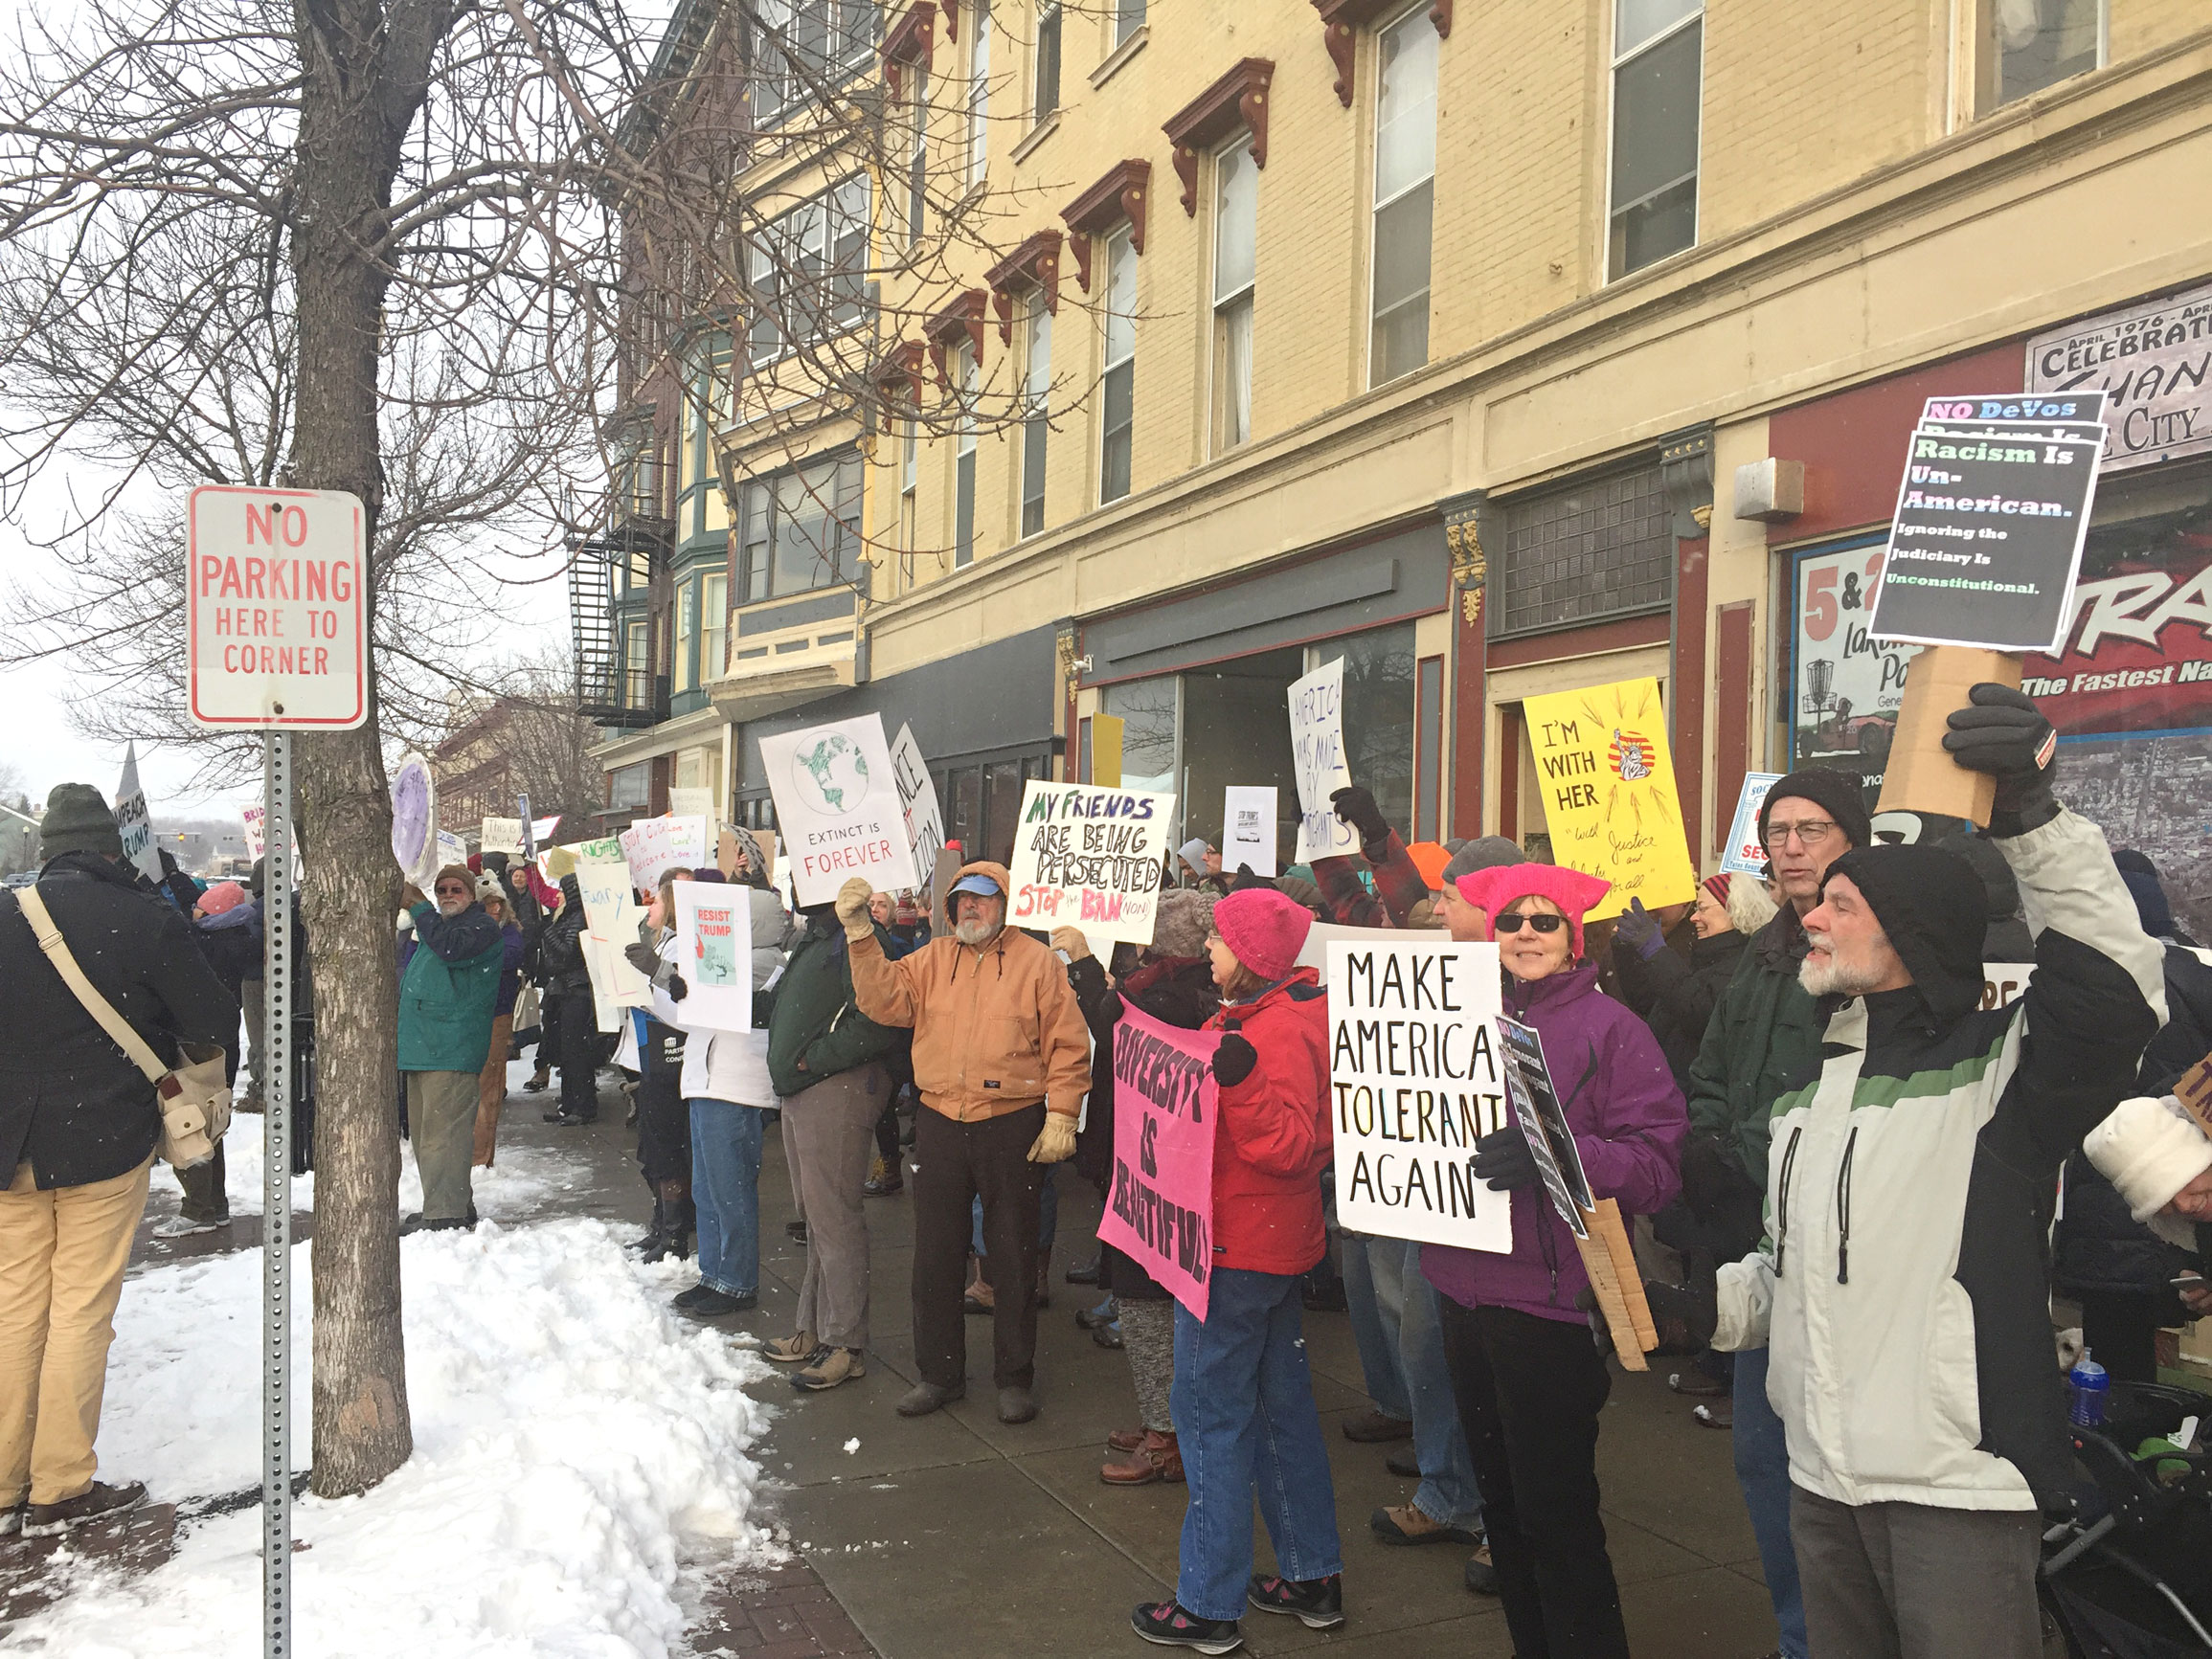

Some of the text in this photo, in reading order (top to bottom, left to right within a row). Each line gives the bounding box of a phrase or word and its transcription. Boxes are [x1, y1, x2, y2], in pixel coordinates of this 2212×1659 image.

[2115, 315, 2164, 337] 1976
[1928, 400, 2077, 419] NO DeVos
[2123, 406, 2201, 452] CITY
[1915, 439, 2074, 464] Racism Is
[1910, 465, 1962, 484] Un-
[1903, 490, 2072, 517] American.
[246, 504, 308, 548] NO
[1897, 524, 2008, 540] Ignoring the
[1890, 549, 1992, 566] Judiciary Is
[201, 555, 351, 602] PARKING
[1885, 573, 2041, 594] Unconstitutional.
[1804, 565, 1840, 641] 5
[1841, 572, 1862, 611] &
[215, 607, 337, 639] HERE TO
[224, 644, 329, 676] CORNER
[2020, 677, 2067, 697] The
[2071, 665, 2176, 693] Fastest
[1542, 719, 1580, 748] I'M
[1543, 751, 1596, 779] WITH
[114, 791, 147, 830] MPEACH
[1026, 790, 1155, 823] MY FRIENDS
[1556, 783, 1599, 811] HER
[124, 822, 148, 860] RUMP
[808, 822, 881, 845] EXTINCT IS
[1030, 823, 1147, 854] ARE BEING
[803, 840, 892, 877] FOREVER
[1036, 851, 1162, 894] PERSECUTED
[697, 908, 731, 922] RESIST
[1080, 888, 1123, 922] BAN
[698, 924, 732, 936] TRUMP
[1346, 952, 1461, 1012] MAKE
[1332, 1020, 1497, 1083] AMERICA
[1116, 1022, 1212, 1124] DIVERSITY
[1333, 1082, 1502, 1149] TOLERANT
[1140, 1111, 1158, 1179] IS
[1349, 1151, 1476, 1219] AGAIN
